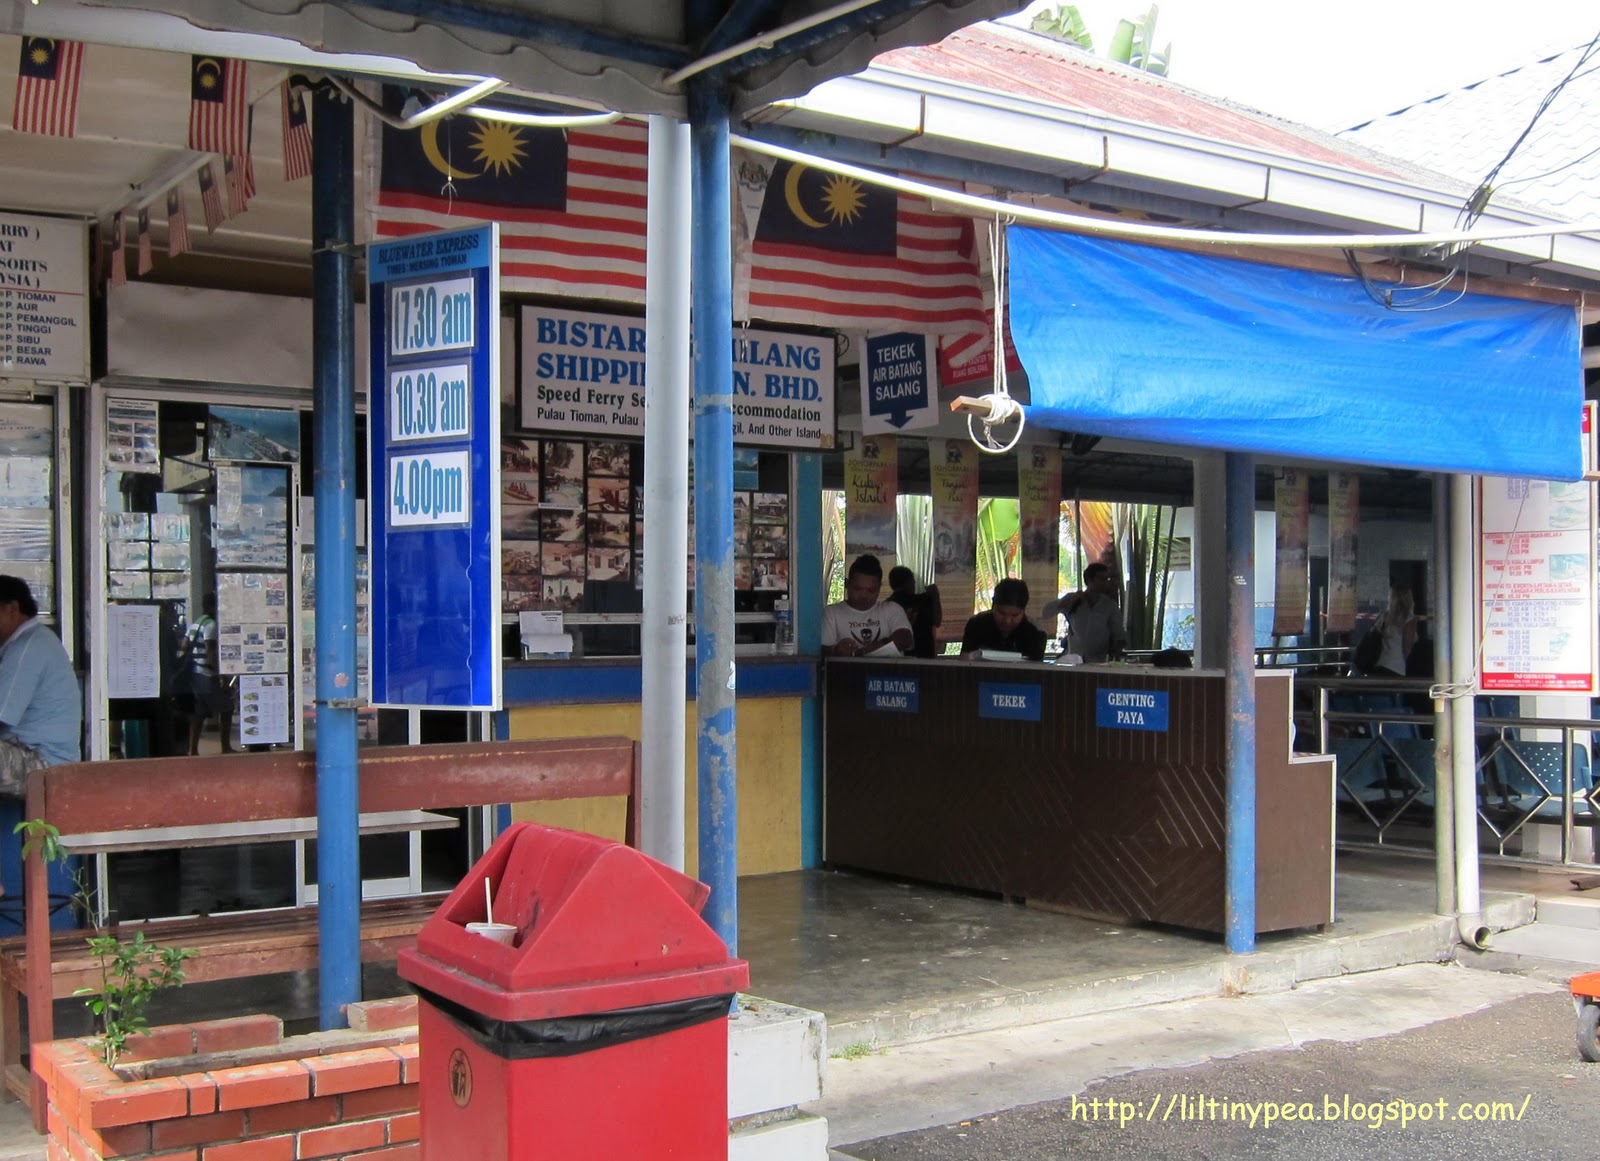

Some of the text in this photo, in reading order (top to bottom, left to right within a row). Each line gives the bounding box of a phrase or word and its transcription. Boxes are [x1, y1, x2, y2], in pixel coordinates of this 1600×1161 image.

[0, 224, 29, 238] RRY
[0, 240, 15, 252] AT
[379, 234, 479, 265] BLUEWATER EXPRESS
[0, 257, 48, 272] SORTS
[0, 271, 31, 287] YSIA
[6, 290, 56, 303] P. TIOMAN
[6, 301, 38, 312] P. AUR
[6, 312, 76, 327] P. PEMANGGIL
[441, 288, 471, 345] am
[6, 322, 51, 334] P. TINGGI
[536, 317, 646, 353] BISTAR
[6, 334, 40, 345] P. SIBU
[6, 344, 51, 356] P. BESAR
[876, 342, 917, 364] TEKEK
[6, 355, 47, 366] P. RAWA
[536, 352, 823, 403] SHIPPI N. BHD.
[873, 360, 923, 383] AIR BATANG
[875, 380, 921, 402] SALANG
[395, 372, 466, 436] 10.30 am
[537, 384, 821, 422] Speed Ferry Se ccommodation
[537, 407, 566, 421] Pulau
[570, 409, 608, 425] Tioman,
[612, 412, 639, 426] Pulau
[748, 423, 765, 435] And
[768, 424, 792, 437] Other
[393, 458, 462, 520] 4.00pm
[868, 680, 916, 694] AIR BATANG
[876, 695, 908, 708] SALANG
[992, 694, 1027, 709] TEKEK
[1107, 692, 1156, 709] GENTING
[1116, 711, 1145, 726] PAYA
